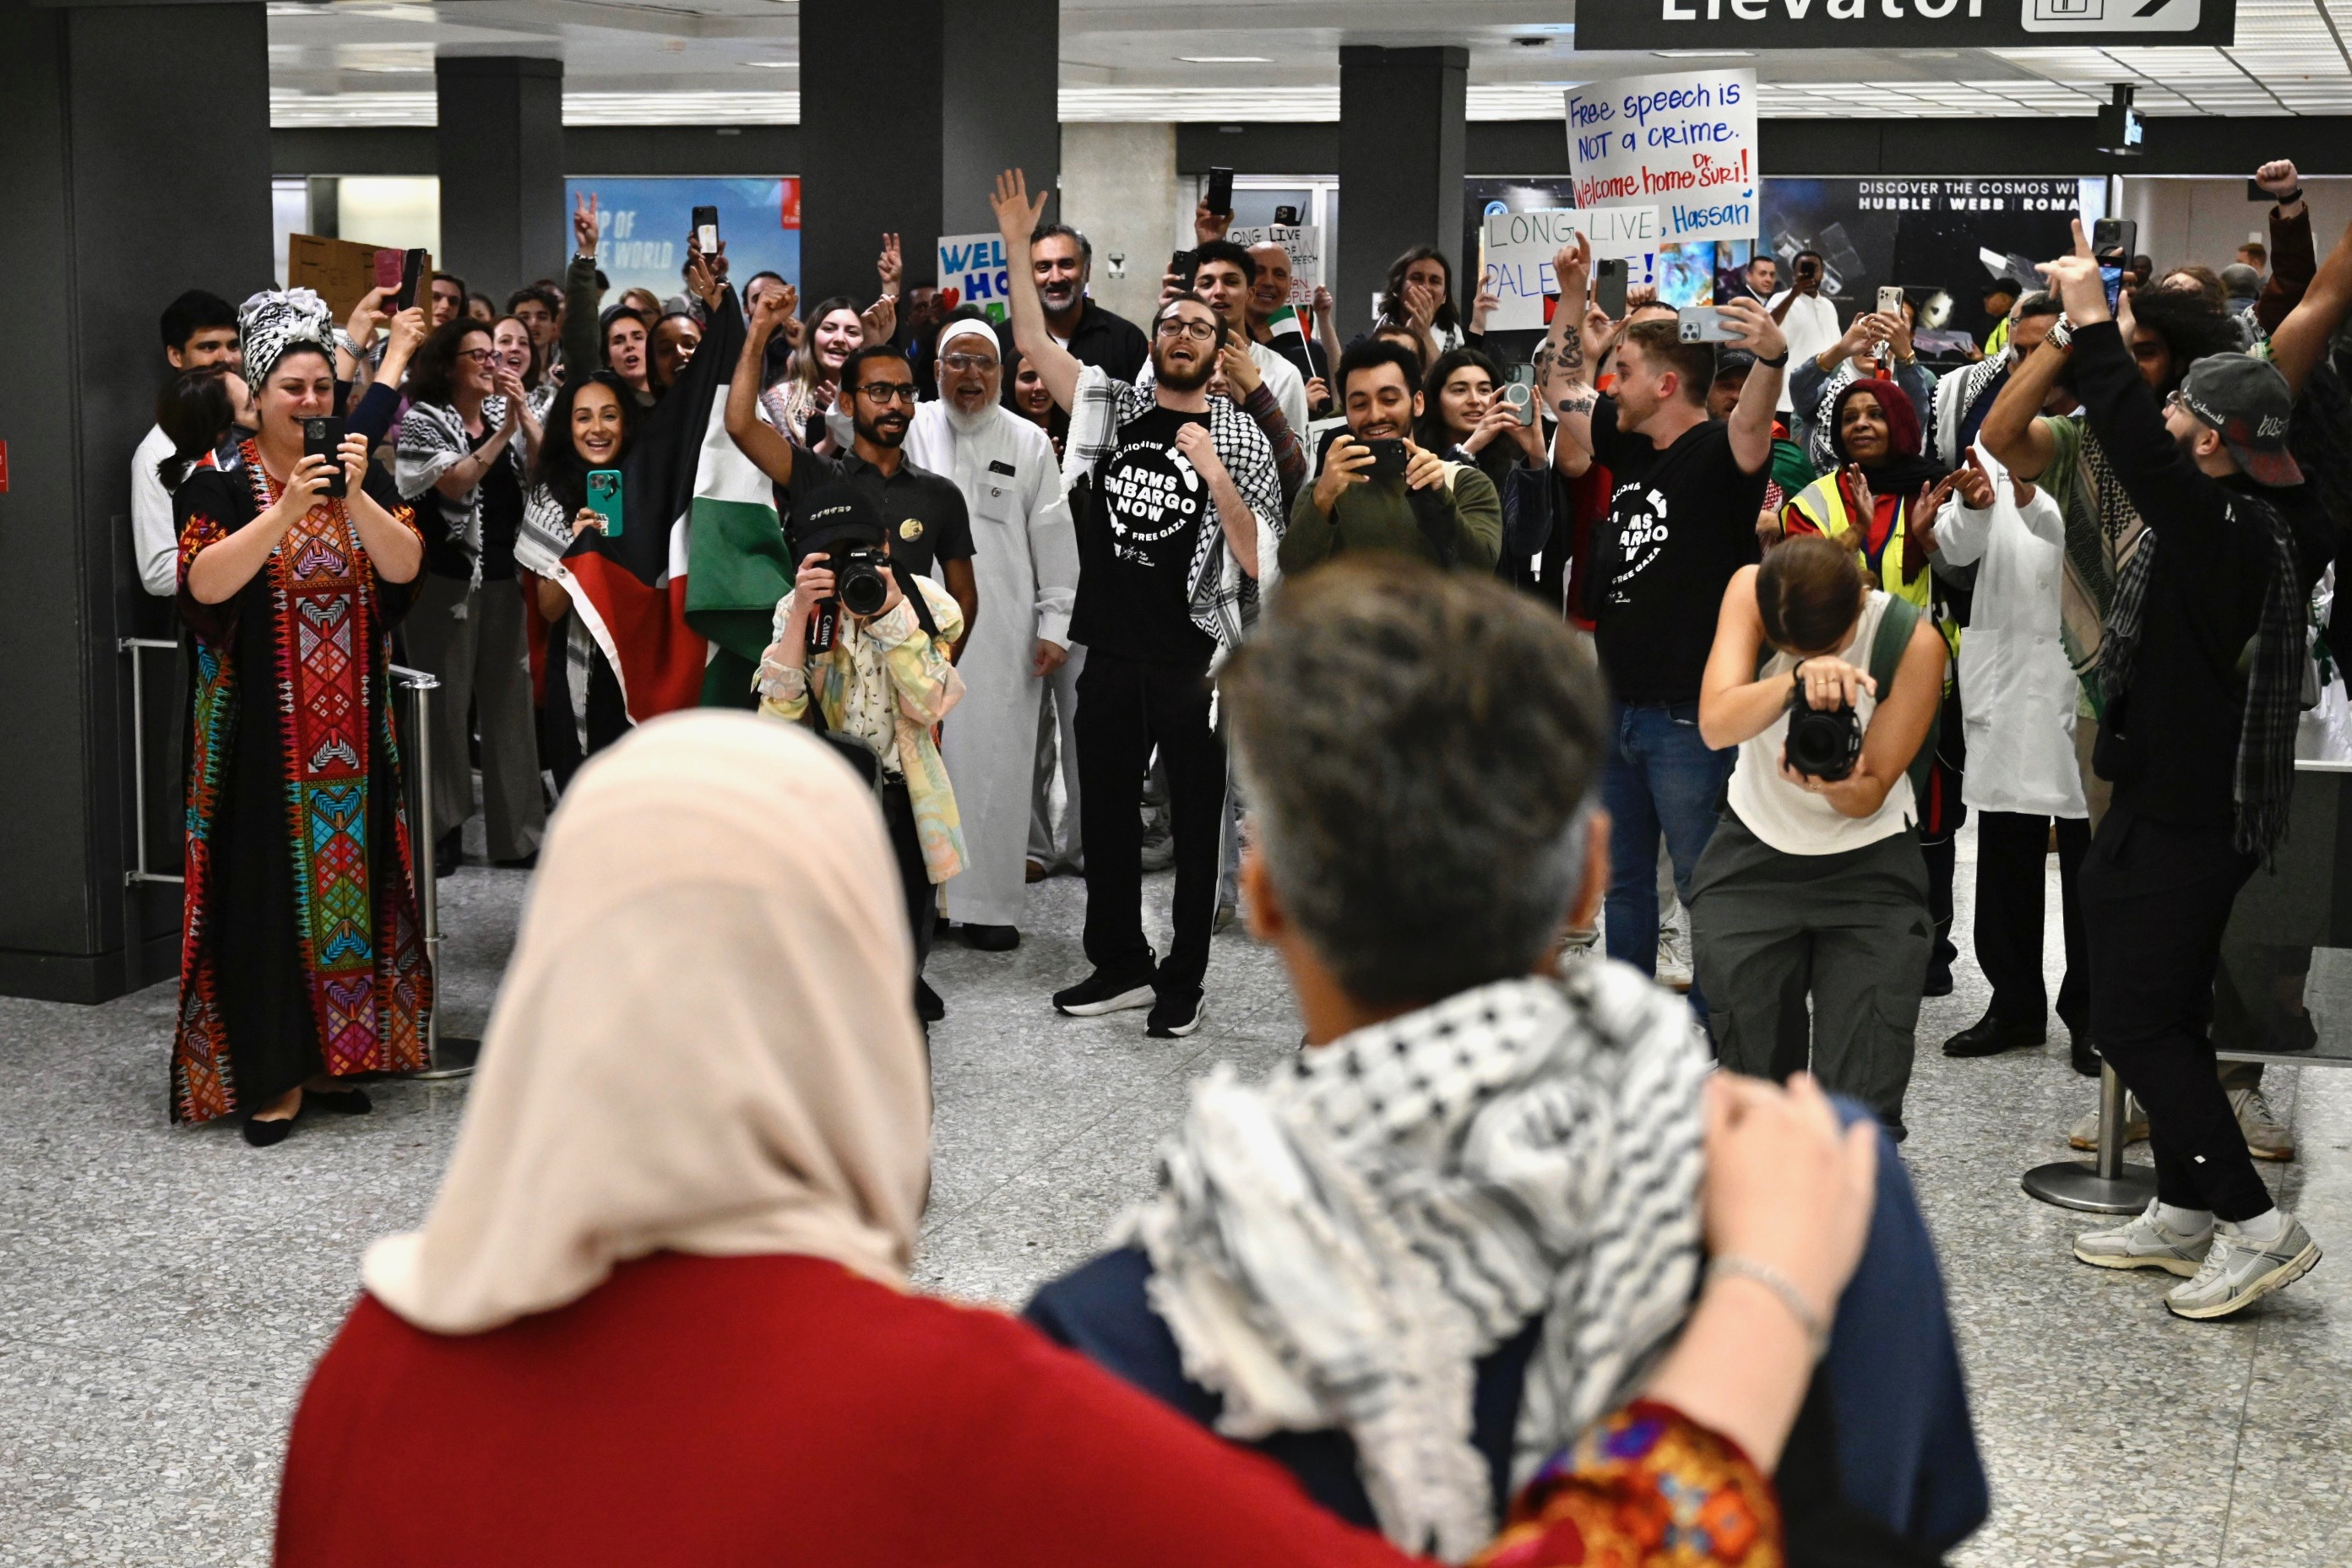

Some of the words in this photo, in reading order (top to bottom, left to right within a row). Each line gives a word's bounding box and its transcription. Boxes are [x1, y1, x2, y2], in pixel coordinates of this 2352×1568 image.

[1624, 83, 1710, 127] speech
[1719, 83, 1741, 106] is
[1578, 132, 1613, 163] NOT
[1621, 133, 1636, 152] a
[1692, 153, 1714, 168] Dr.
[1573, 176, 1639, 209] Welcome
[1642, 165, 1696, 195] home
[1859, 182, 1939, 194] DISCOVER
[1944, 182, 1973, 194] THE
[1979, 182, 2050, 194] COSMOS
[2056, 182, 2087, 194] WI
[1858, 198, 1931, 210] HUBBLE
[1949, 198, 2004, 210] WEBB
[2023, 198, 2089, 210] ROMA
[1489, 214, 1575, 248] LONG
[1589, 211, 1654, 241] LIVE
[1672, 203, 1749, 234] Hassan
[1230, 229, 1261, 244] ONG
[1269, 227, 1301, 242] LIVE
[1290, 255, 1318, 265] PEECH
[1118, 464, 1177, 491] ARMS
[1105, 475, 1196, 514] EMBARGO
[1116, 496, 1164, 522] NOW
[1132, 531, 1158, 541] FREE
[1160, 518, 1187, 538] GAZA
